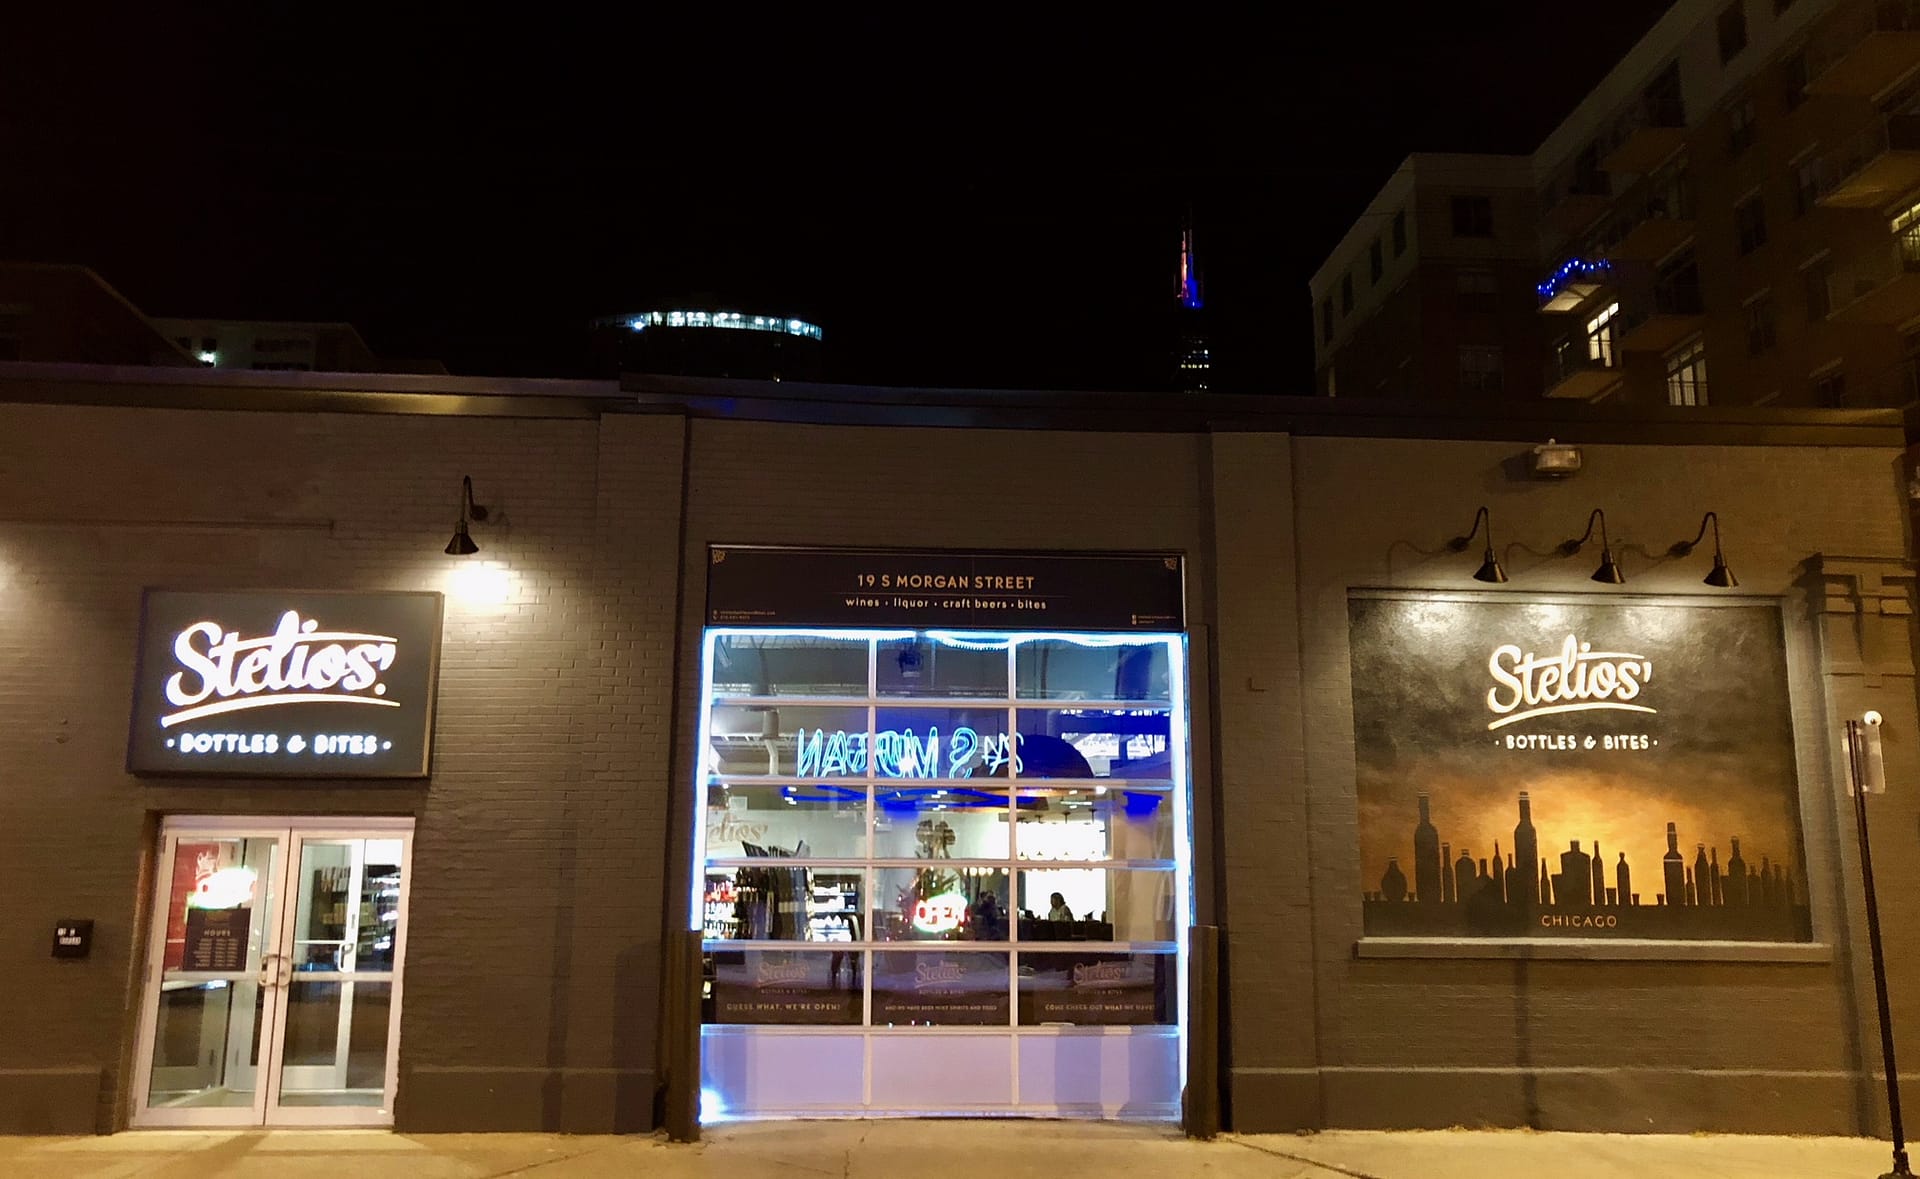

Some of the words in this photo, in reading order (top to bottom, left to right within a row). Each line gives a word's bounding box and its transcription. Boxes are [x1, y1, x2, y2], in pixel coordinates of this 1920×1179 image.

[857, 574, 875, 587] 19
[881, 574, 891, 588] S
[896, 575, 969, 588] MORGAN
[974, 576, 1035, 589] STREET
[845, 597, 880, 607] wines
[893, 597, 929, 609] liquor
[943, 598, 971, 609] craft
[975, 598, 1007, 609] beers
[1017, 599, 1047, 610] bites
[180, 733, 279, 754] BOTTLES
[286, 734, 306, 754] &
[314, 734, 378, 755] BITES
[1505, 734, 1577, 750] BOTTLES
[1583, 735, 1597, 750] &
[1603, 735, 1649, 751] BITES
[1541, 914, 1617, 928] CHICAGO
